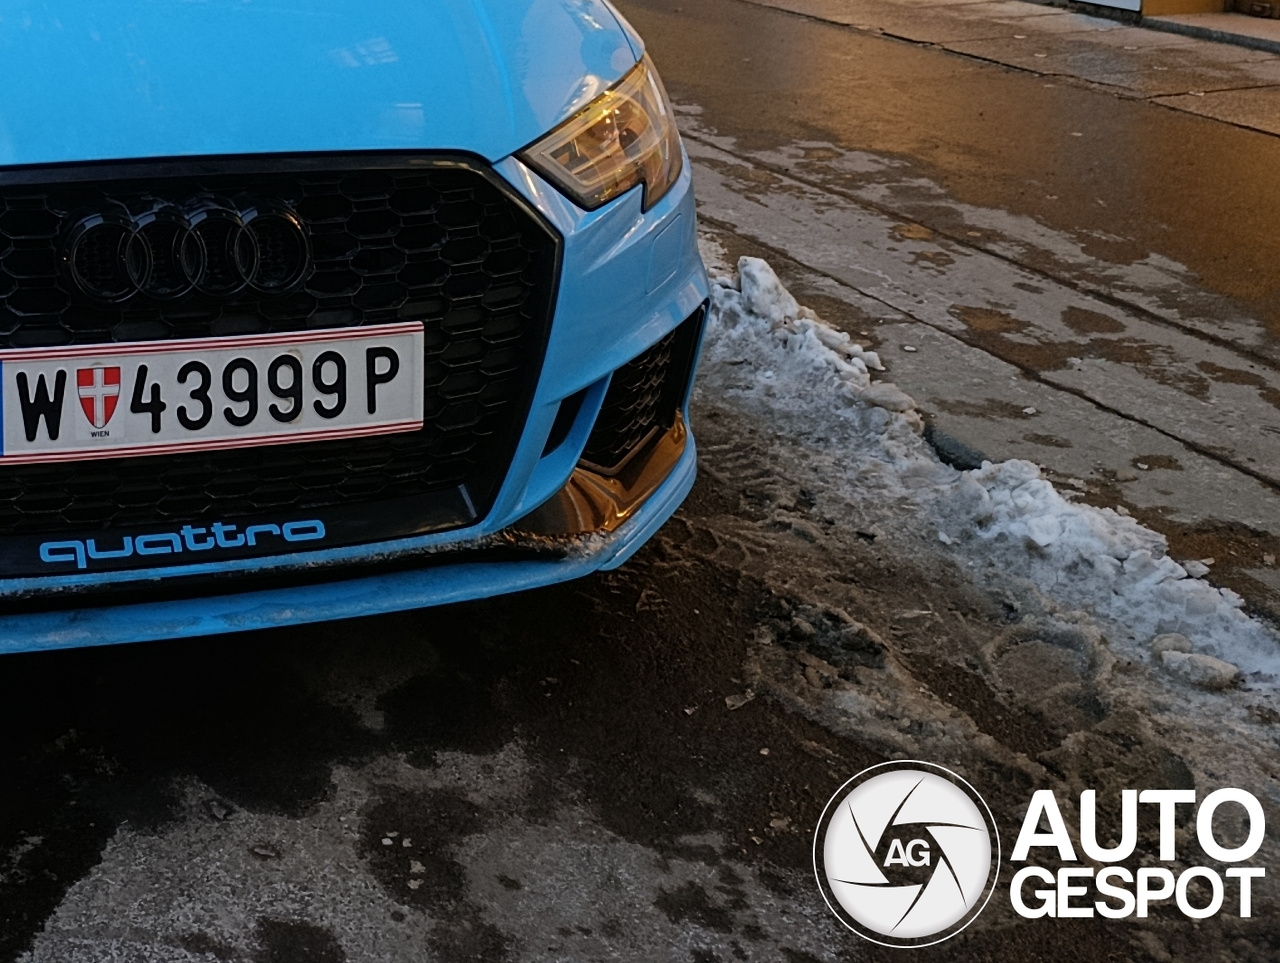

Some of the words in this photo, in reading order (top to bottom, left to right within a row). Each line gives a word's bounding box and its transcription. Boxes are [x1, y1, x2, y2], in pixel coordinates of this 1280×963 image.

[16, 369, 67, 442] W
[130, 349, 348, 434] 43999
[365, 344, 402, 416] P
[90, 430, 110, 439] WIEN
[39, 518, 326, 569] quattro
